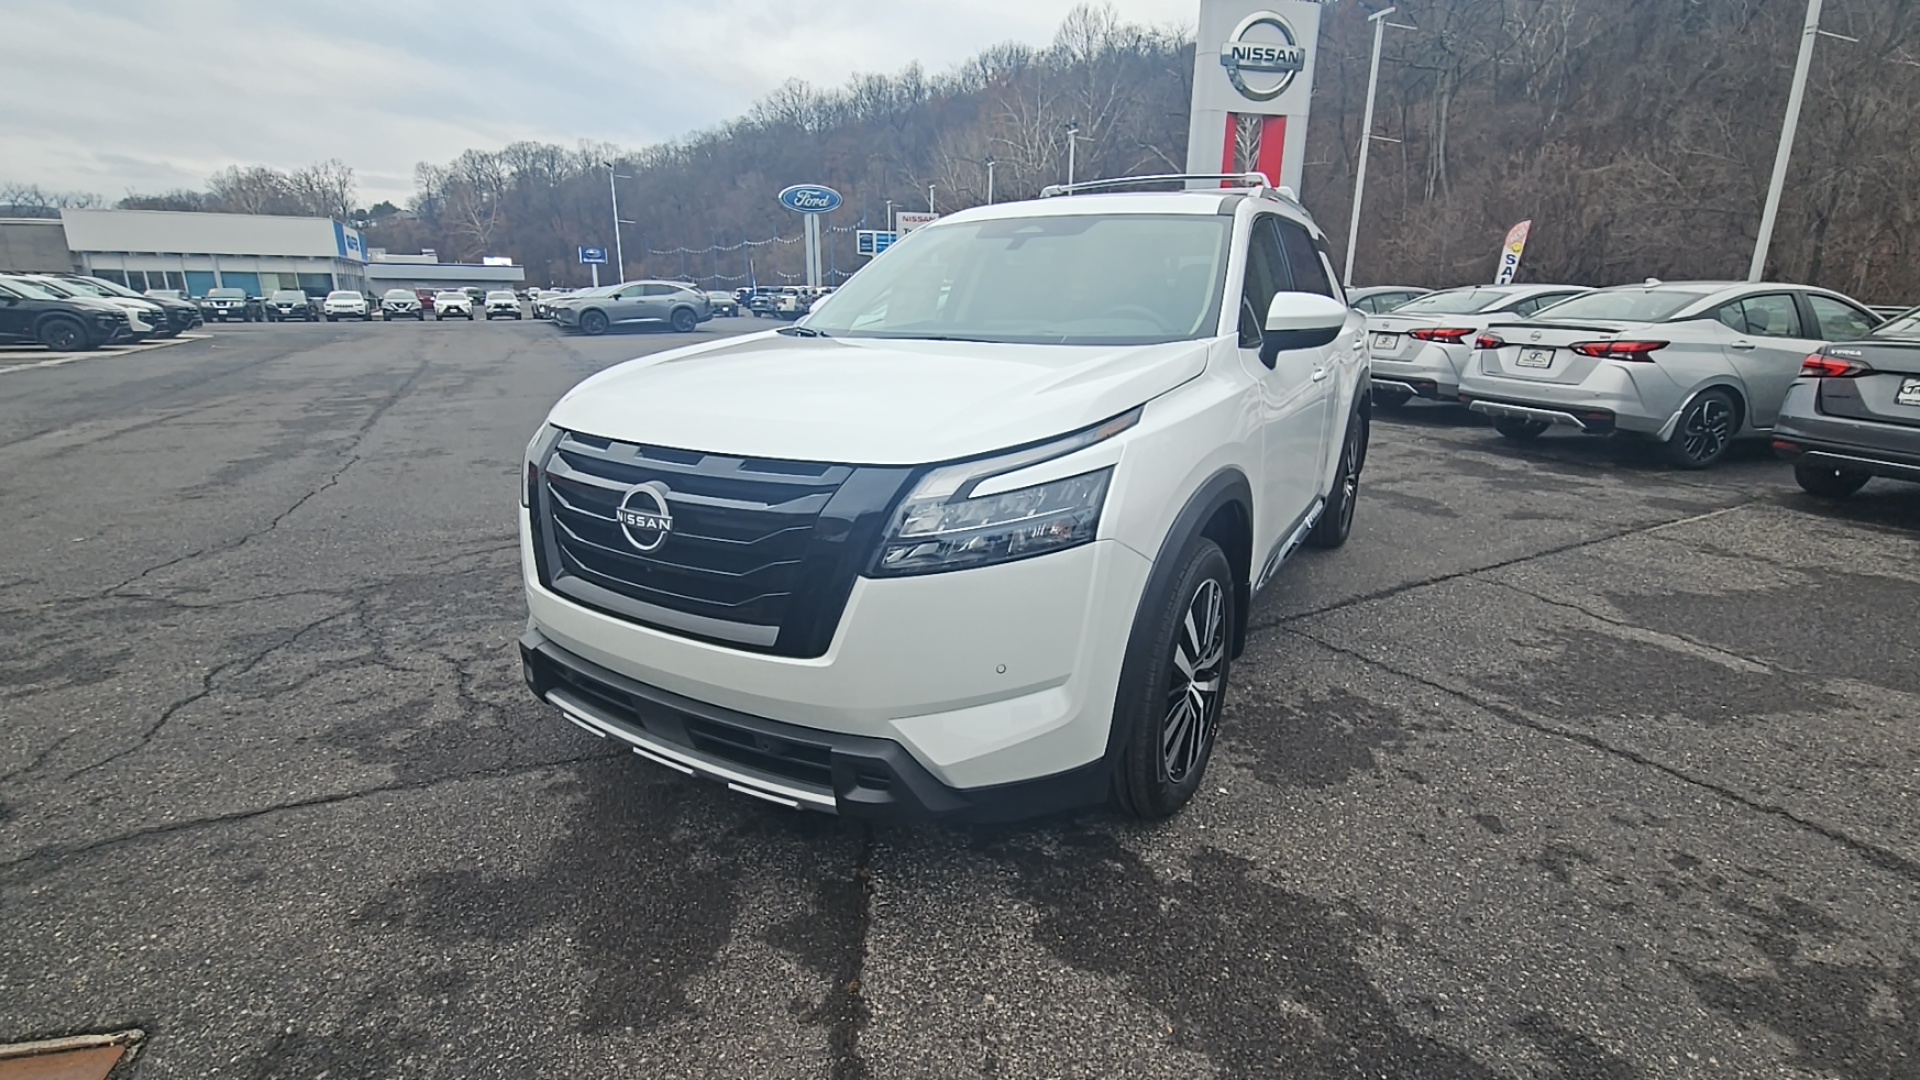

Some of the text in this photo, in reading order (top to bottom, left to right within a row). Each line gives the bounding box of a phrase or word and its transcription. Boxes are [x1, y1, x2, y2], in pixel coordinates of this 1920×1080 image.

[1232, 47, 1299, 64] NISSAN
[794, 190, 829, 208] Ford
[617, 510, 671, 531] NISSAN
